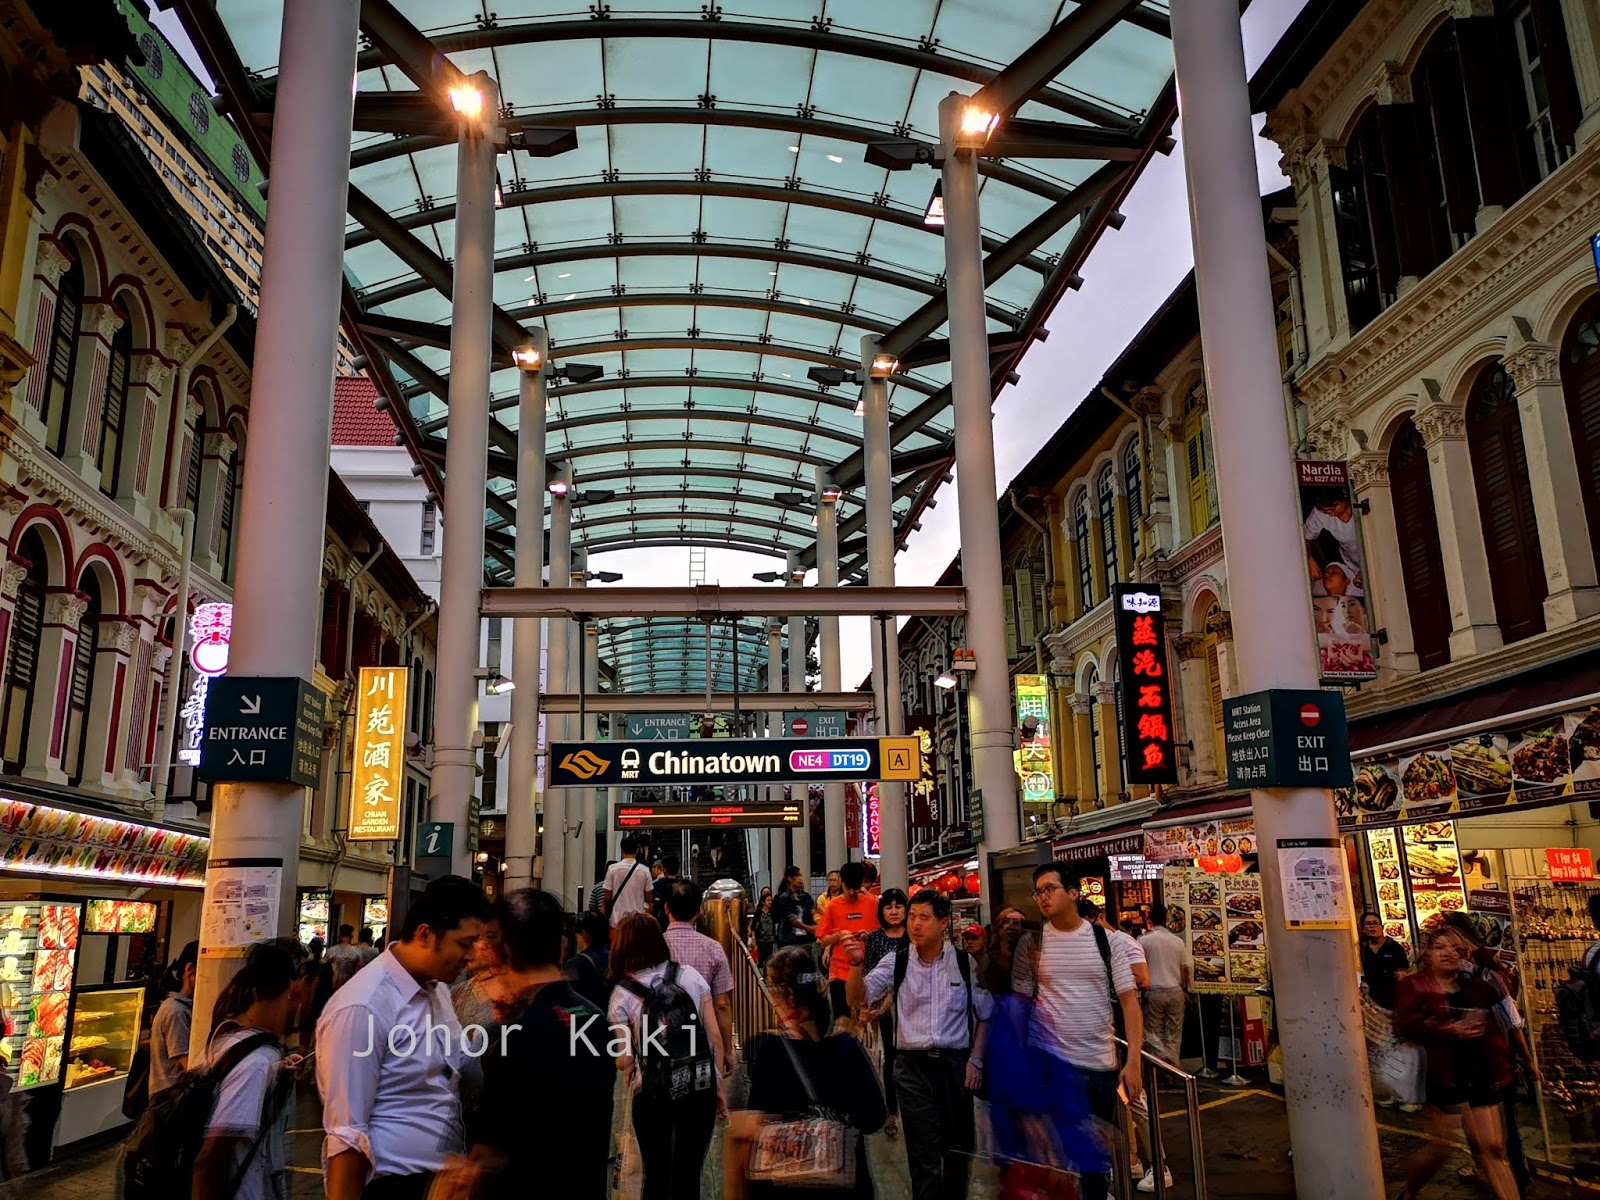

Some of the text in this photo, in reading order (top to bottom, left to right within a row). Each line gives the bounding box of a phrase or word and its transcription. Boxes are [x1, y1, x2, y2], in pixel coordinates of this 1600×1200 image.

[1302, 463, 1342, 475] Nardia
[1126, 597, 1159, 608] 味知源
[1231, 703, 1261, 717] MRT Station
[644, 718, 687, 727] ENTRANCE
[818, 716, 836, 725] EXIT
[1233, 717, 1261, 729] Access Area
[208, 726, 288, 740] ENTRANCE
[363, 671, 395, 807] 川苑酒家
[1227, 728, 1270, 743] Please Keep Clear
[1297, 735, 1325, 748] EXIT
[226, 748, 266, 766] 入口
[1231, 746, 1269, 763] 地铁出入口
[648, 750, 904, 775] Chinatown NE4 DT19 A
[1298, 754, 1329, 772] 出口
[621, 770, 640, 779] MRT
[1236, 764, 1267, 781] 请勿占用
[364, 810, 387, 818] CHUAN
[868, 785, 880, 850] CSANOVA
[361, 818, 389, 826] GARDEN
[353, 825, 396, 833] RESTAURANT
[1554, 852, 1581, 865] 1 For $4
[1563, 866, 1568, 878] 3
[1568, 866, 1578, 878] For
[1580, 866, 1592, 879] $10
